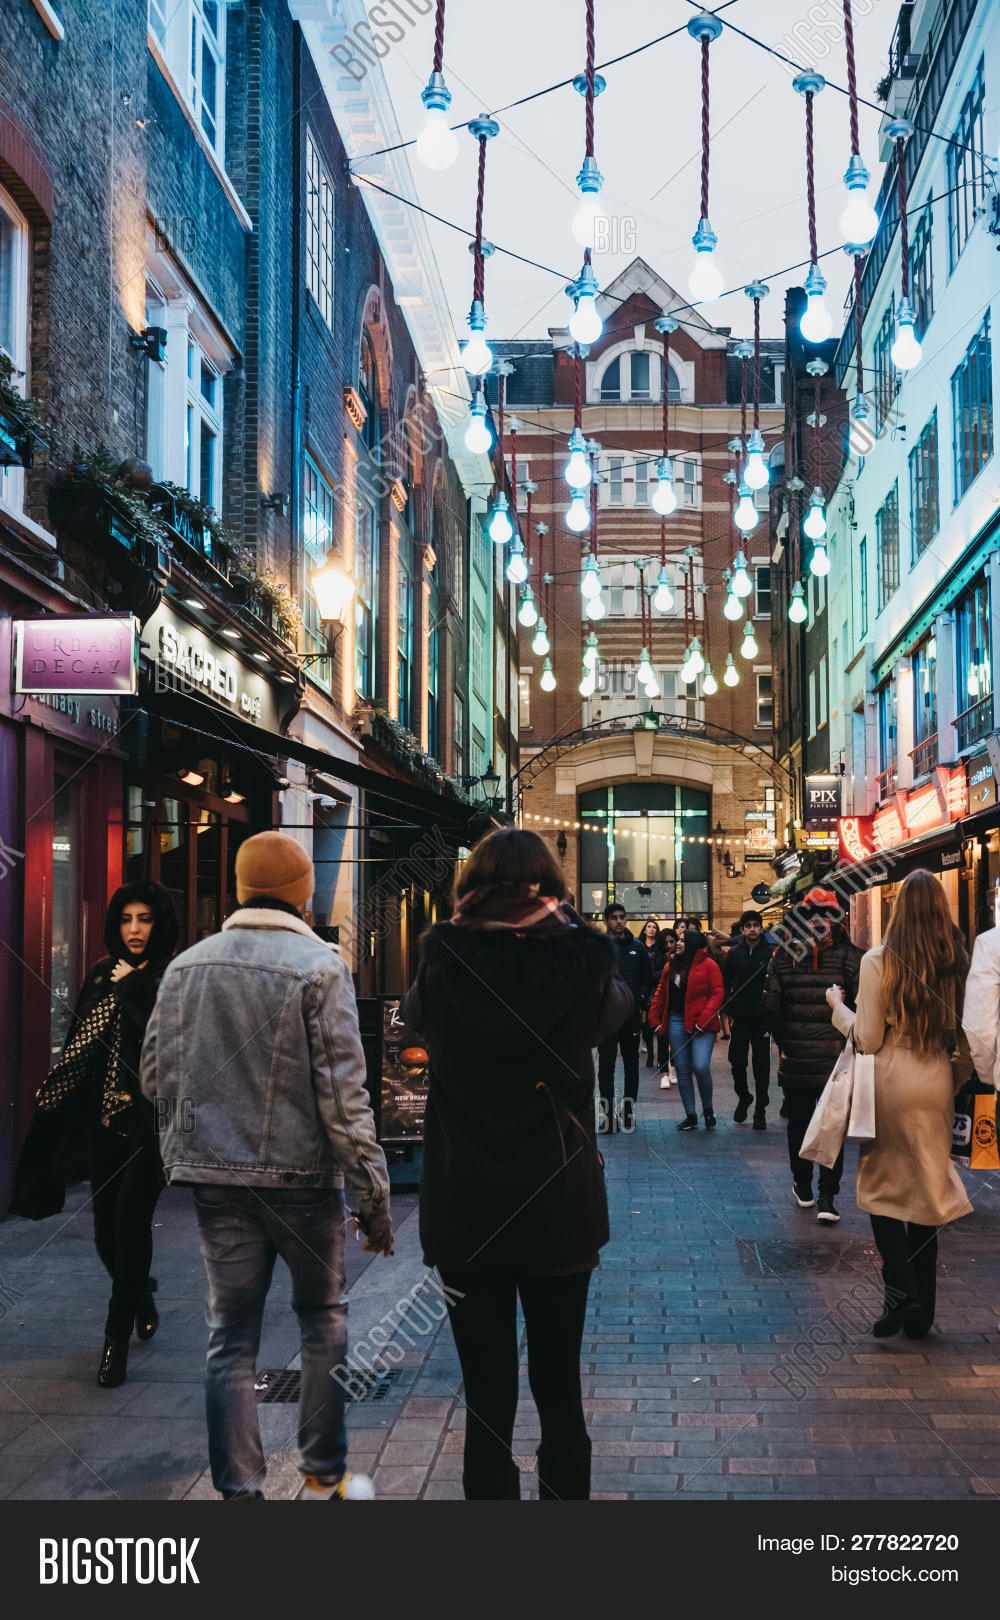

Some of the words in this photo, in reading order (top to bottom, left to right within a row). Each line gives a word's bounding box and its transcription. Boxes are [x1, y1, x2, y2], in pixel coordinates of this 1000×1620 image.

[32, 637, 123, 657] URBAN
[32, 659, 120, 674] DECAY
[159, 622, 238, 703] SACRED
[91, 708, 119, 735] stree
[809, 790, 837, 802] PIX
